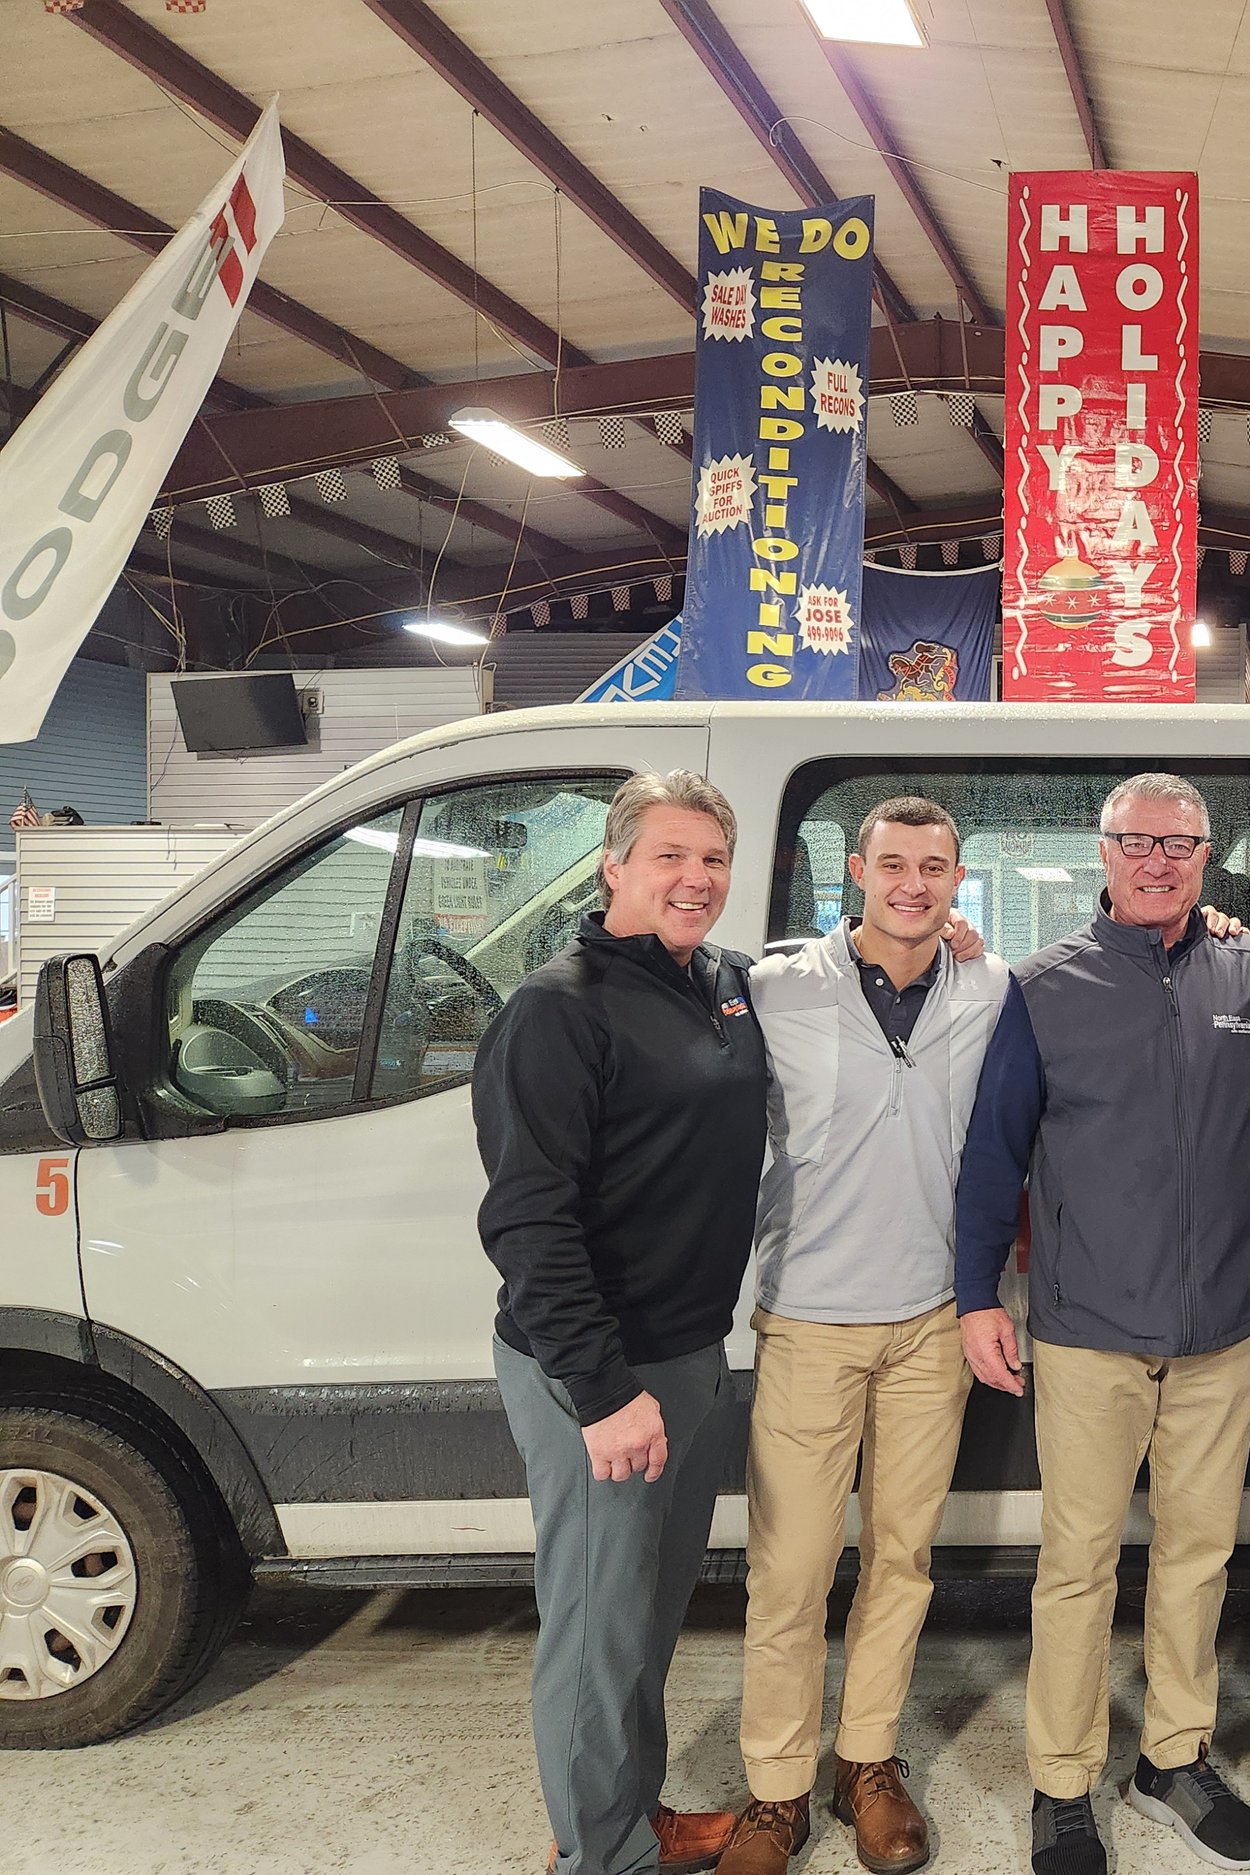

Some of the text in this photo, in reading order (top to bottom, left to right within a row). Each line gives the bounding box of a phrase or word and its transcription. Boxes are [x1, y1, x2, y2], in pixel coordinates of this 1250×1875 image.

[702, 211, 870, 260] WE DO
[711, 284, 747, 306] SALE DAY
[710, 306, 746, 329] WASHES
[1036, 204, 1088, 491] HAPPY
[827, 371, 848, 393] FULL
[820, 393, 855, 417] RECONS
[1110, 205, 1165, 667] HOLIDAYS
[0, 228, 235, 679] ODGE
[710, 466, 740, 484] QUICK
[746, 260, 805, 688] RECONDITIONING
[709, 479, 742, 497] SPIFFS
[713, 495, 733, 509] FOR
[702, 504, 743, 524] AUCTION
[808, 595, 838, 608] ASK FOR
[805, 608, 842, 624] JOSE
[807, 625, 844, 642] 499-9096
[35, 1158, 69, 1216] 5
